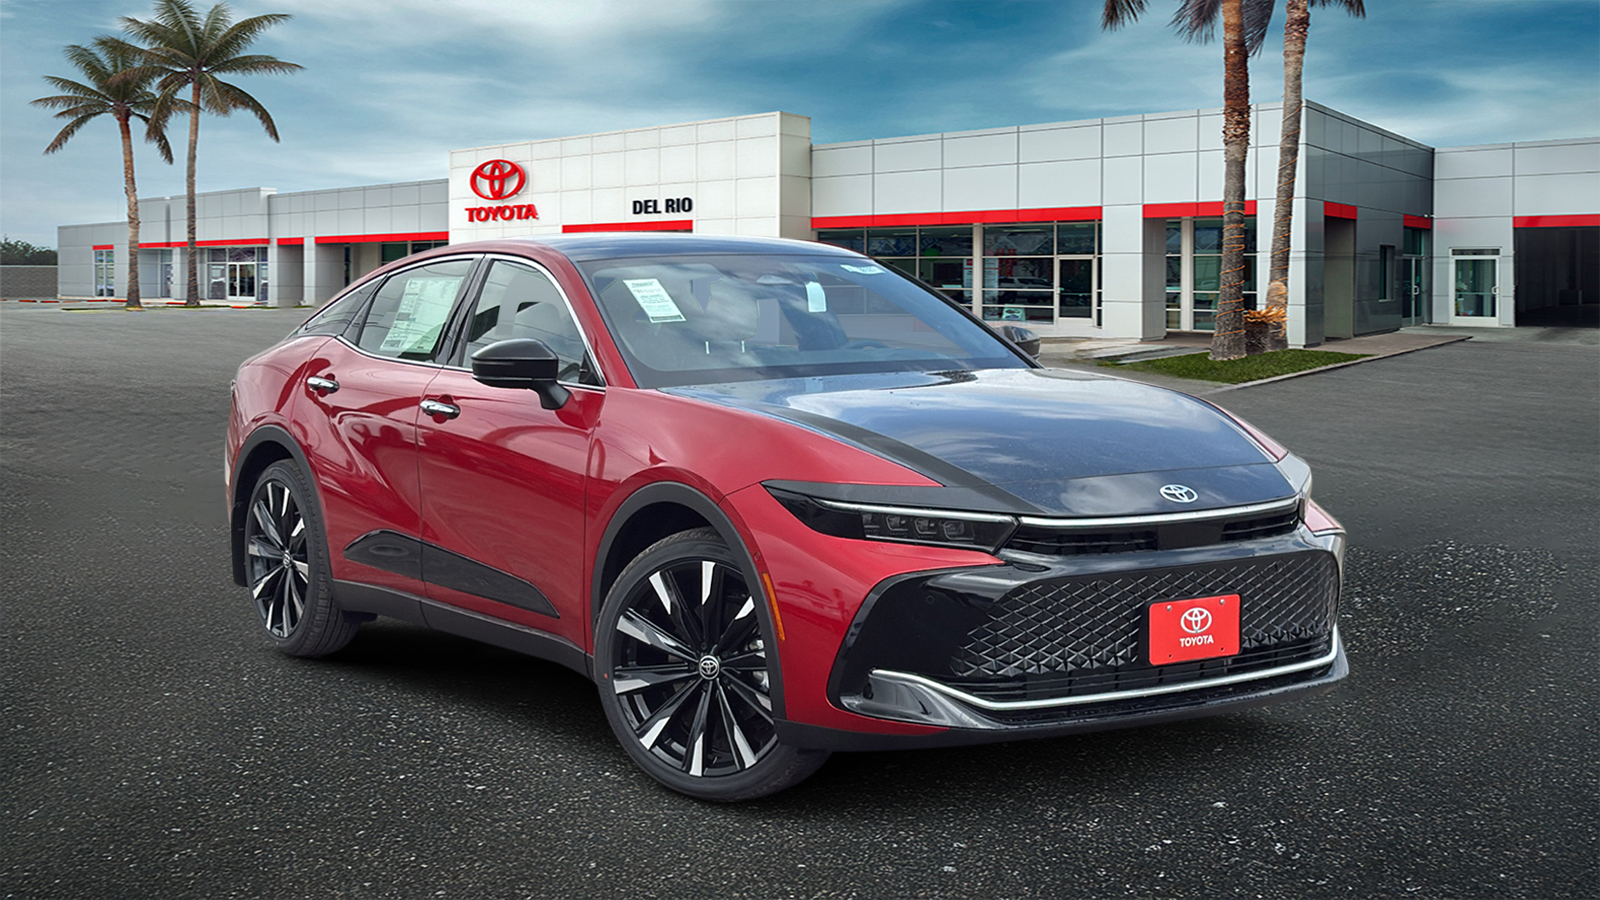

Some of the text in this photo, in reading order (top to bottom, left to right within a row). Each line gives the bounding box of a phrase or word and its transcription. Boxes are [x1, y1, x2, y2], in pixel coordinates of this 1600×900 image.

[465, 204, 538, 222] TOYOTA
[632, 197, 693, 215] DEL RIO
[1179, 635, 1214, 647] TOYOTA
